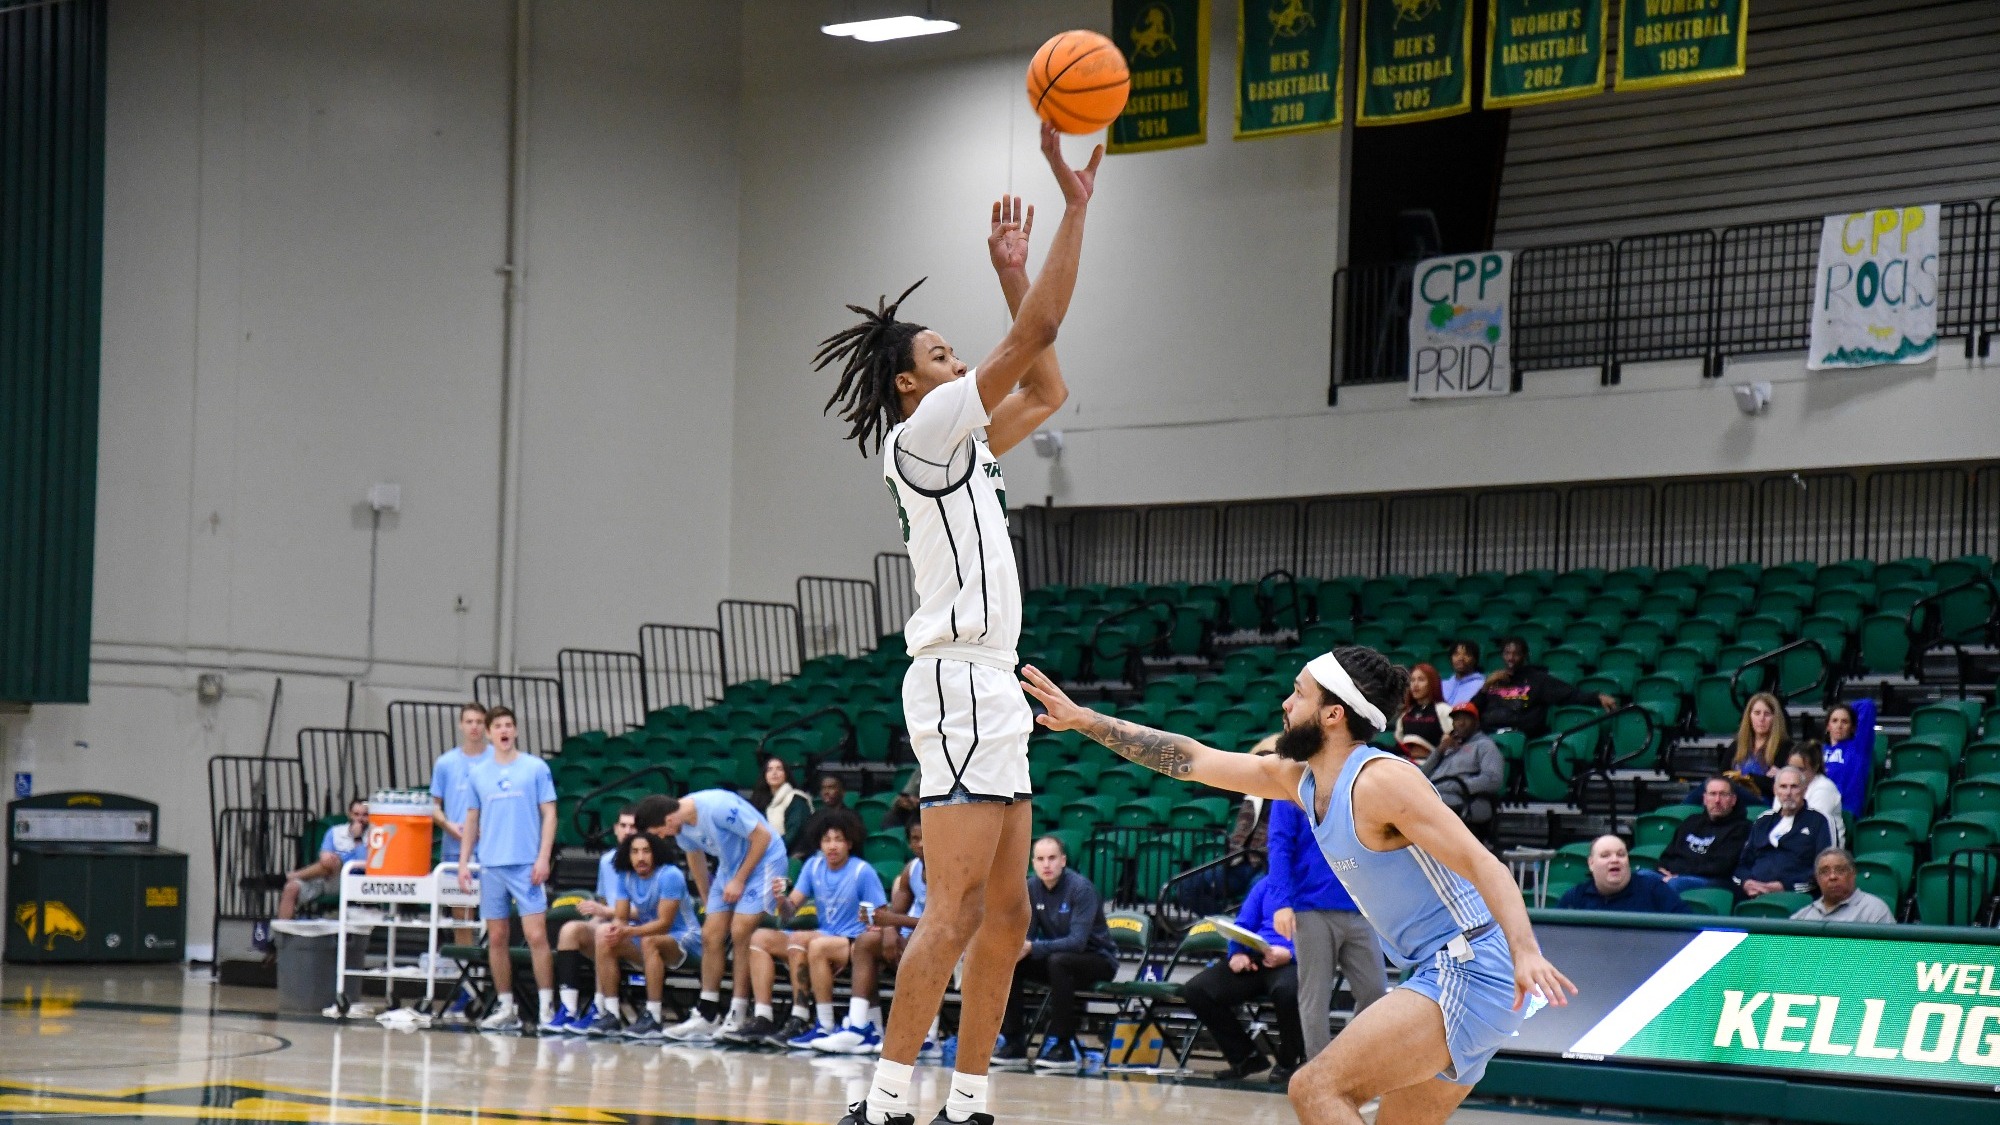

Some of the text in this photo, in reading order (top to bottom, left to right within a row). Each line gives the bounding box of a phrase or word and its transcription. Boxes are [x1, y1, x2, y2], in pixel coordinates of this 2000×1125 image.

[1511, 8, 1582, 37] WOMEN'S
[1634, 13, 1730, 47] BASKETBALL
[1393, 34, 1436, 59] MEN'S
[1503, 34, 1589, 65] BASKETBALL
[1660, 46, 1700, 71] 1993
[1270, 50, 1310, 73] MEN'S
[1372, 55, 1453, 86] BASKETBALL
[1131, 66, 1183, 90] OMEN'S
[1249, 73, 1330, 101] BASKETBALL
[1524, 66, 1565, 89] 2002
[1122, 90, 1188, 115] ASKETBALL
[1394, 87, 1431, 111] 2005
[1271, 103, 1305, 124] 2010
[1842, 206, 1926, 257] CPP
[1420, 254, 1503, 304] CPP
[1333, 857, 1360, 873] STATE
[361, 882, 417, 896] GATORADE
[1916, 961, 2000, 997] WEL
[1713, 990, 2000, 1068] KELLOG
